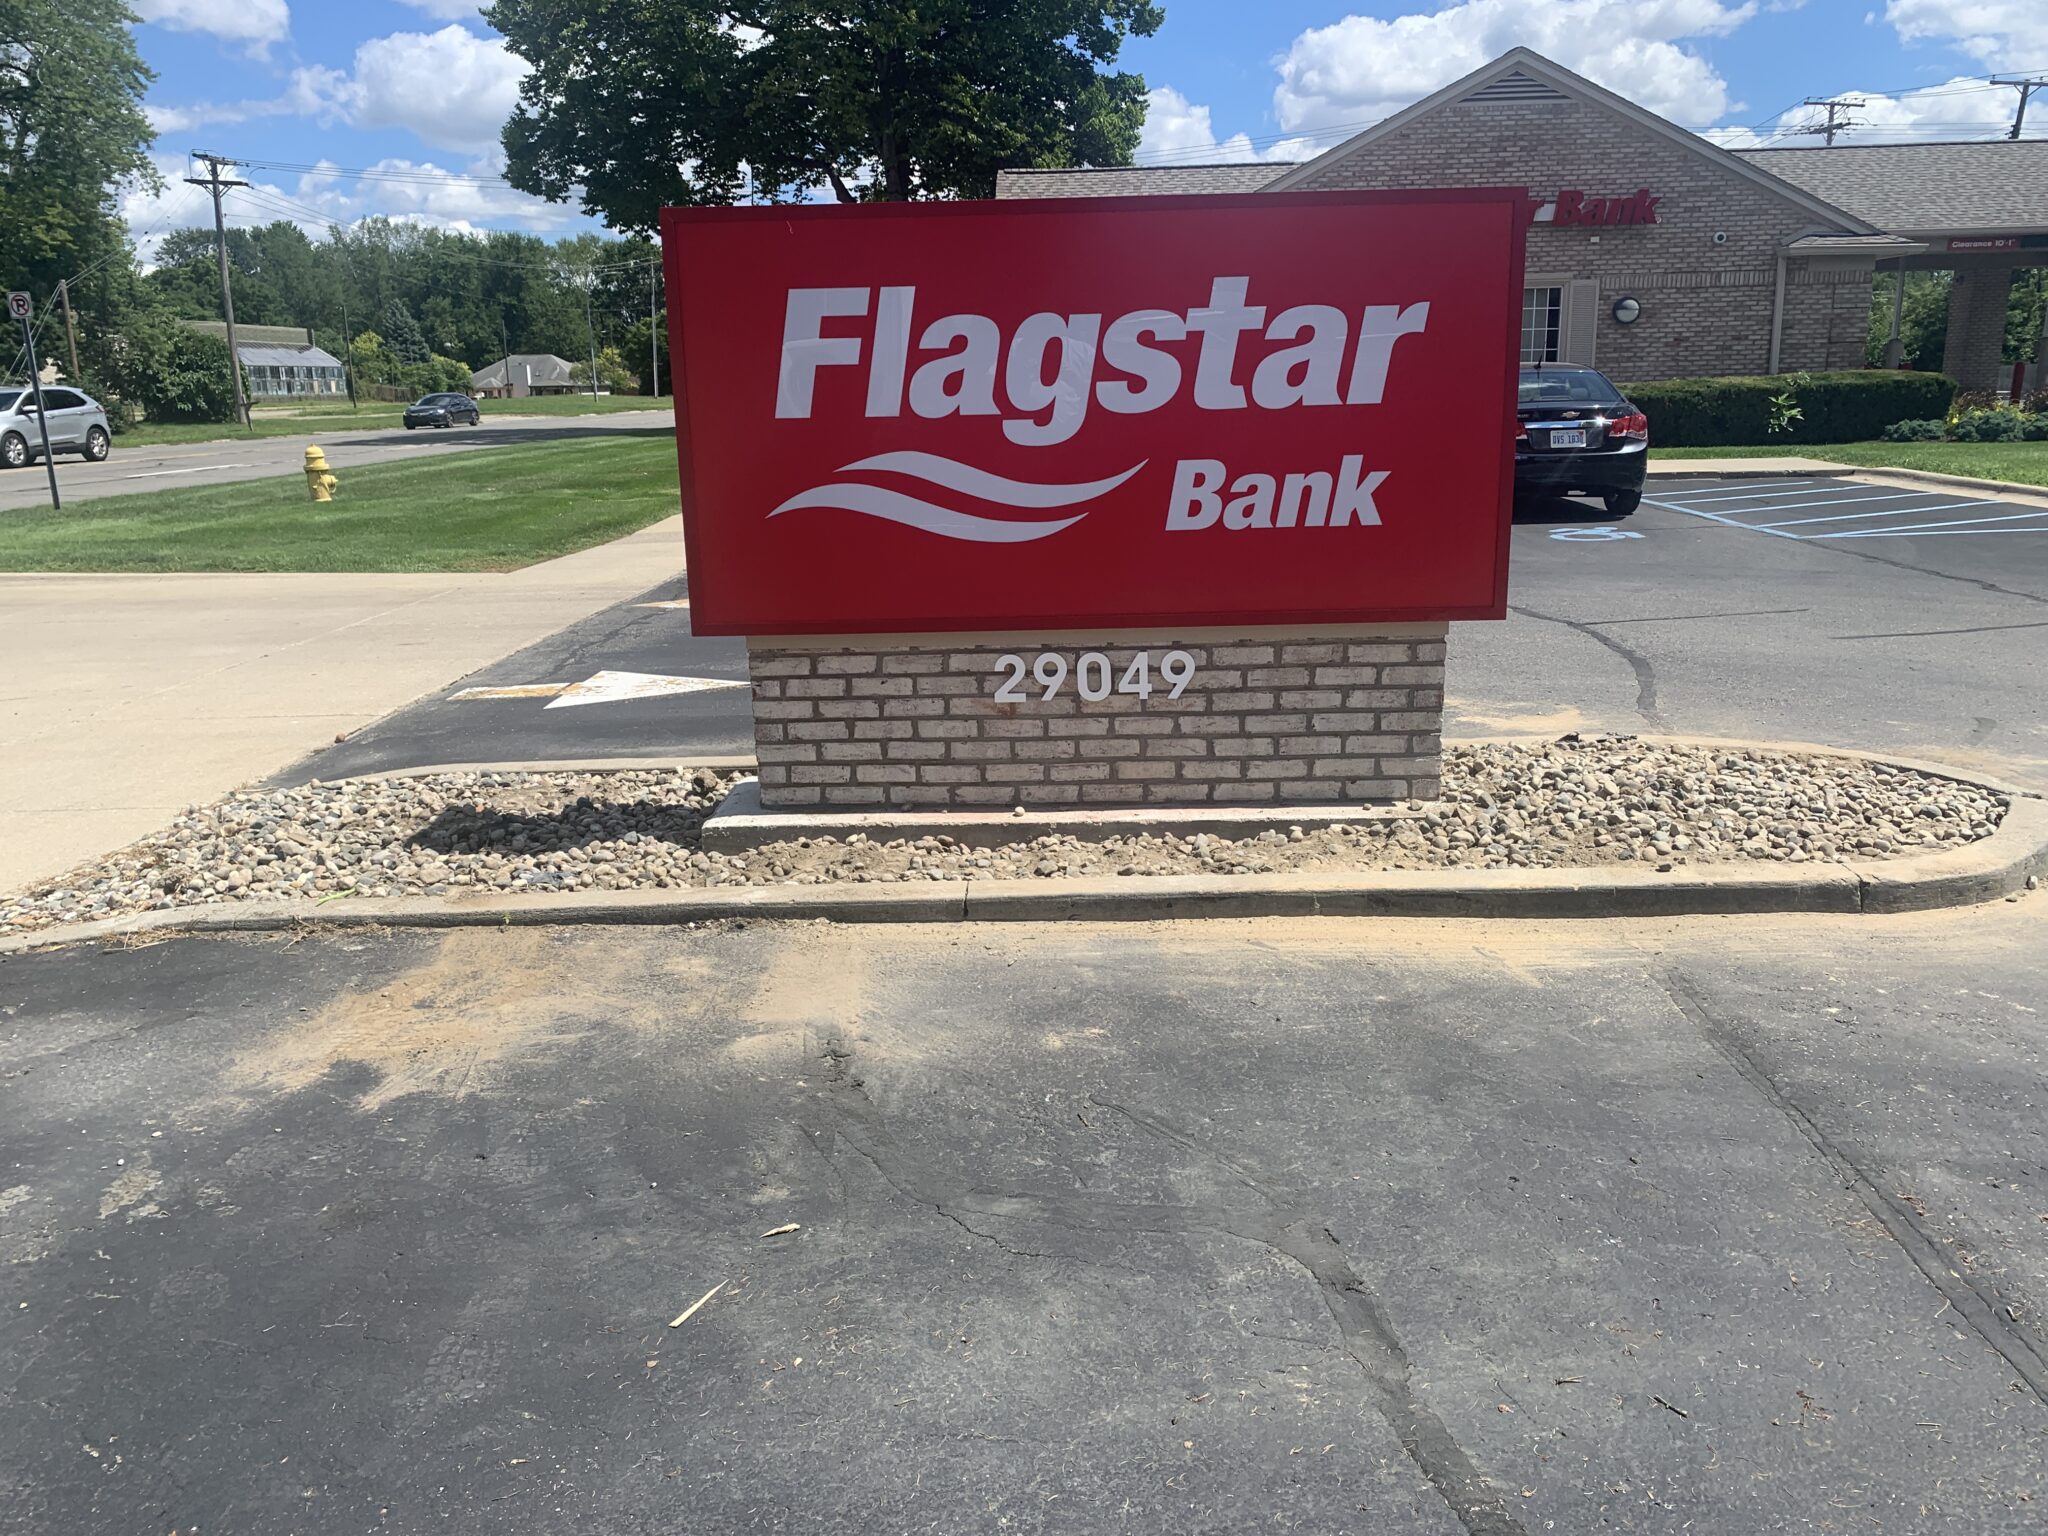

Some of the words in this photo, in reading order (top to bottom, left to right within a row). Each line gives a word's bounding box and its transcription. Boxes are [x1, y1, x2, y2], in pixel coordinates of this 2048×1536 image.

[1551, 189, 1662, 226] Bank
[775, 276, 1430, 447] Flagstar
[1165, 454, 1391, 531] Bank
[994, 649, 1196, 702] 29049
